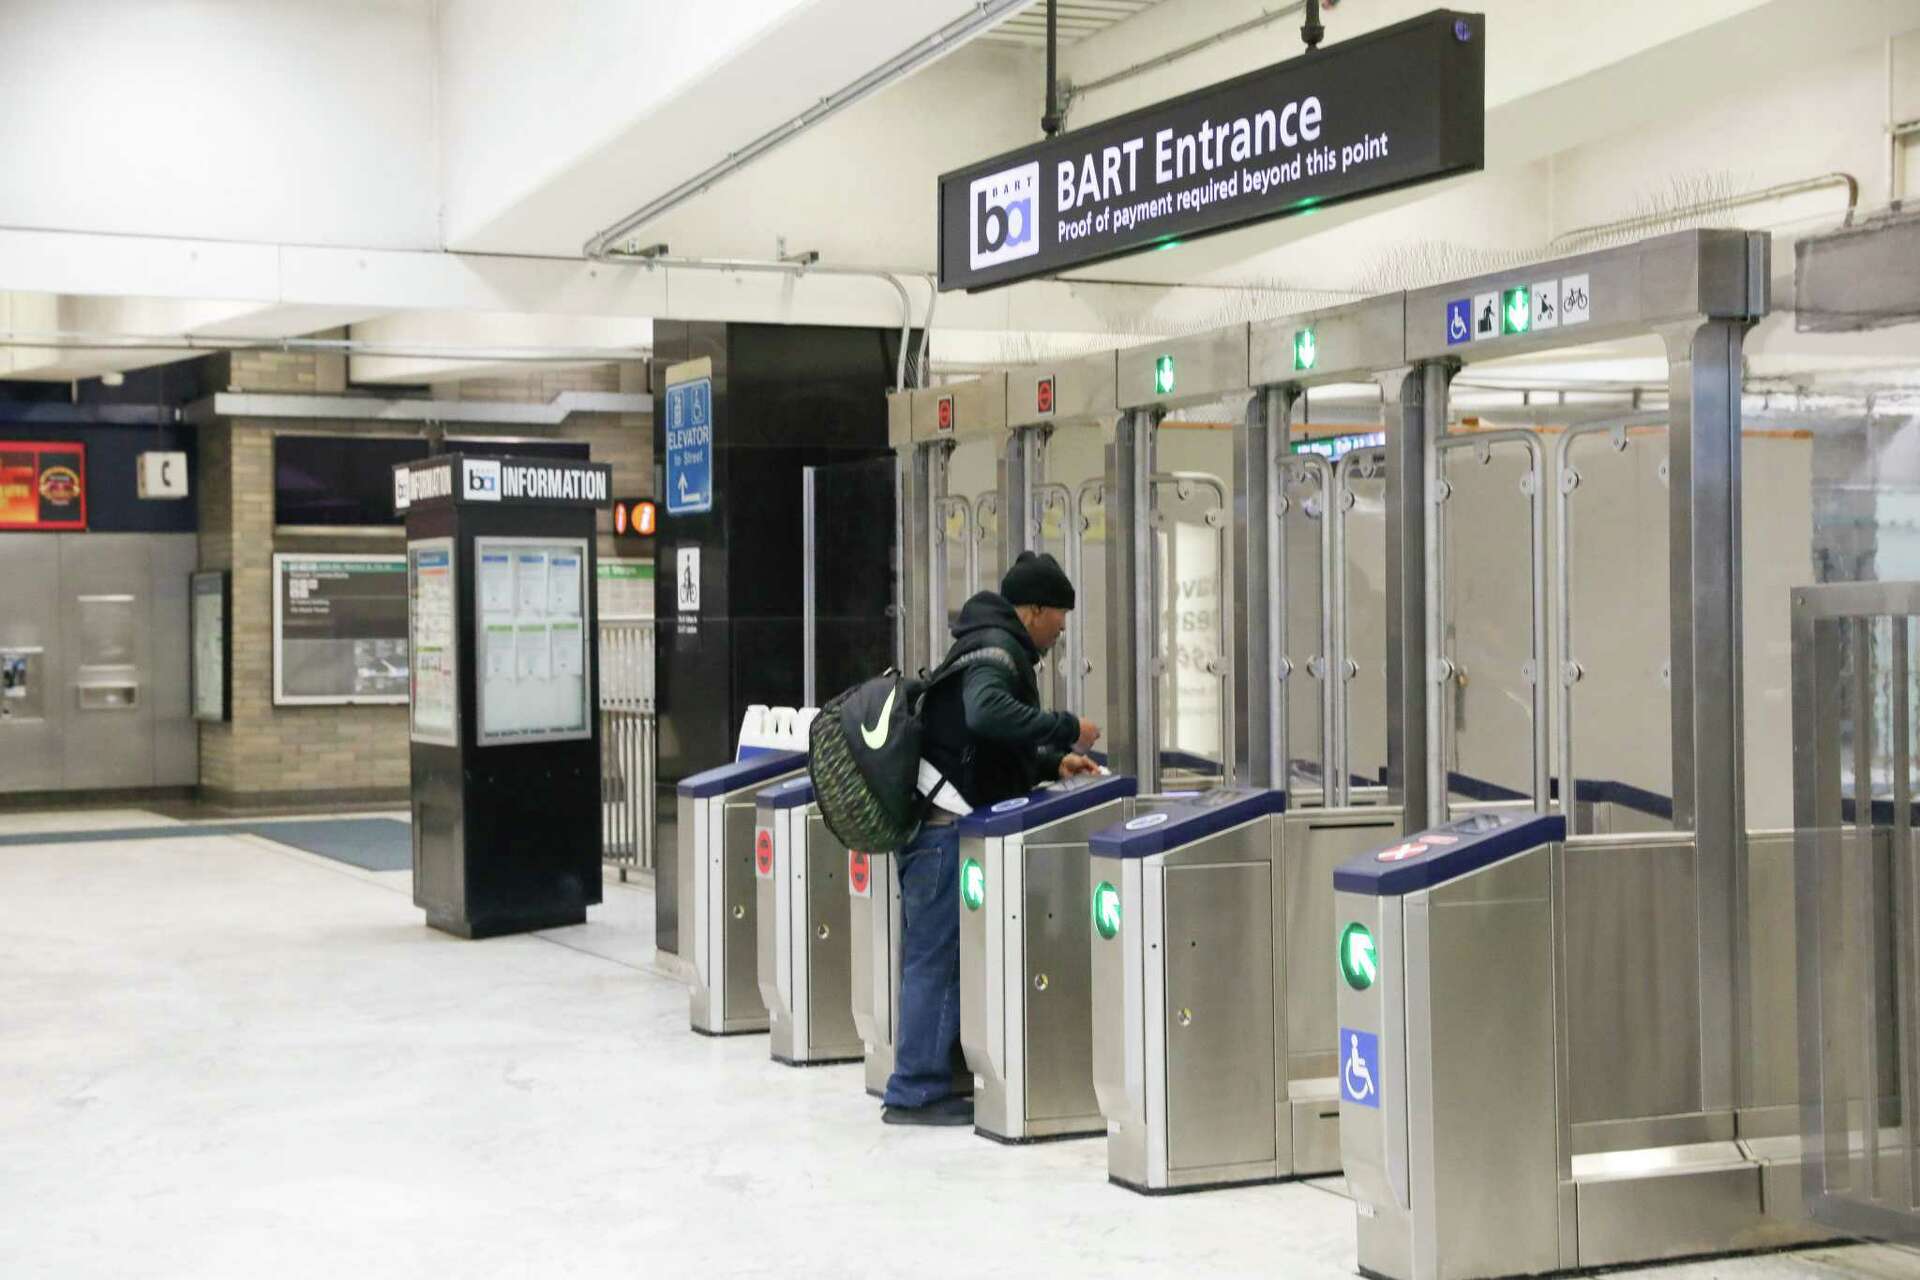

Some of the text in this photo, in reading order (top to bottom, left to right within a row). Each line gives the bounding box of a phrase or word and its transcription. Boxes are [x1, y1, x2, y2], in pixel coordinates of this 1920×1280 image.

[1058, 96, 1322, 212] BART Entrance
[992, 176, 1032, 198] BART
[1058, 131, 1389, 243] Proof of payment required beyond this point
[668, 425, 709, 450] ELEVATOR
[502, 466, 607, 500] INFORMATION
